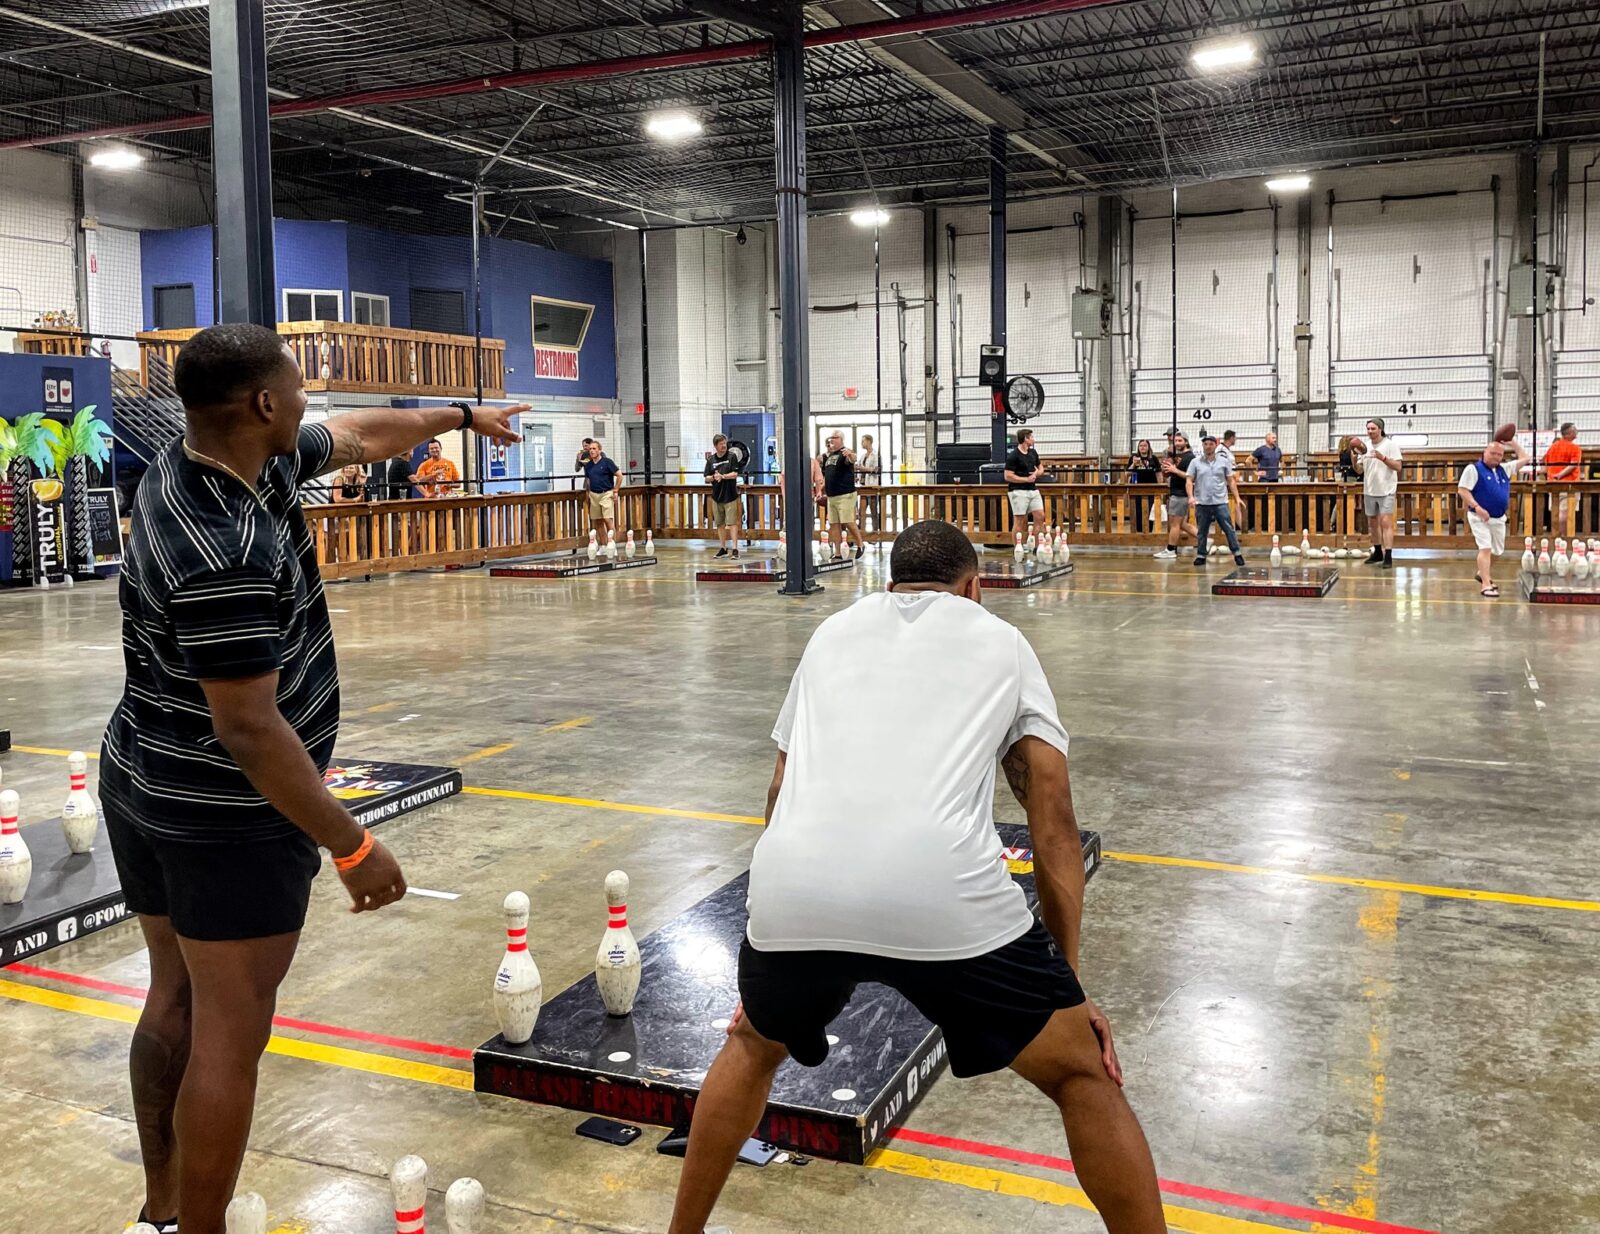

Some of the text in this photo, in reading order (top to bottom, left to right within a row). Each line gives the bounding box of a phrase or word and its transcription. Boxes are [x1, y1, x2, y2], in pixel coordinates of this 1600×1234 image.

[536, 349, 577, 378] RESTROOMS
[1193, 409, 1211, 420] 40
[1398, 403, 1416, 415] 41
[36, 503, 57, 571] TRULY
[401, 781, 454, 810] CINCINNATI
[13, 931, 48, 956] AND
[83, 901, 132, 929] @FOW
[491, 1064, 584, 1106] PLEASE
[592, 1081, 677, 1123] RESET
[768, 1111, 842, 1154] PINS
